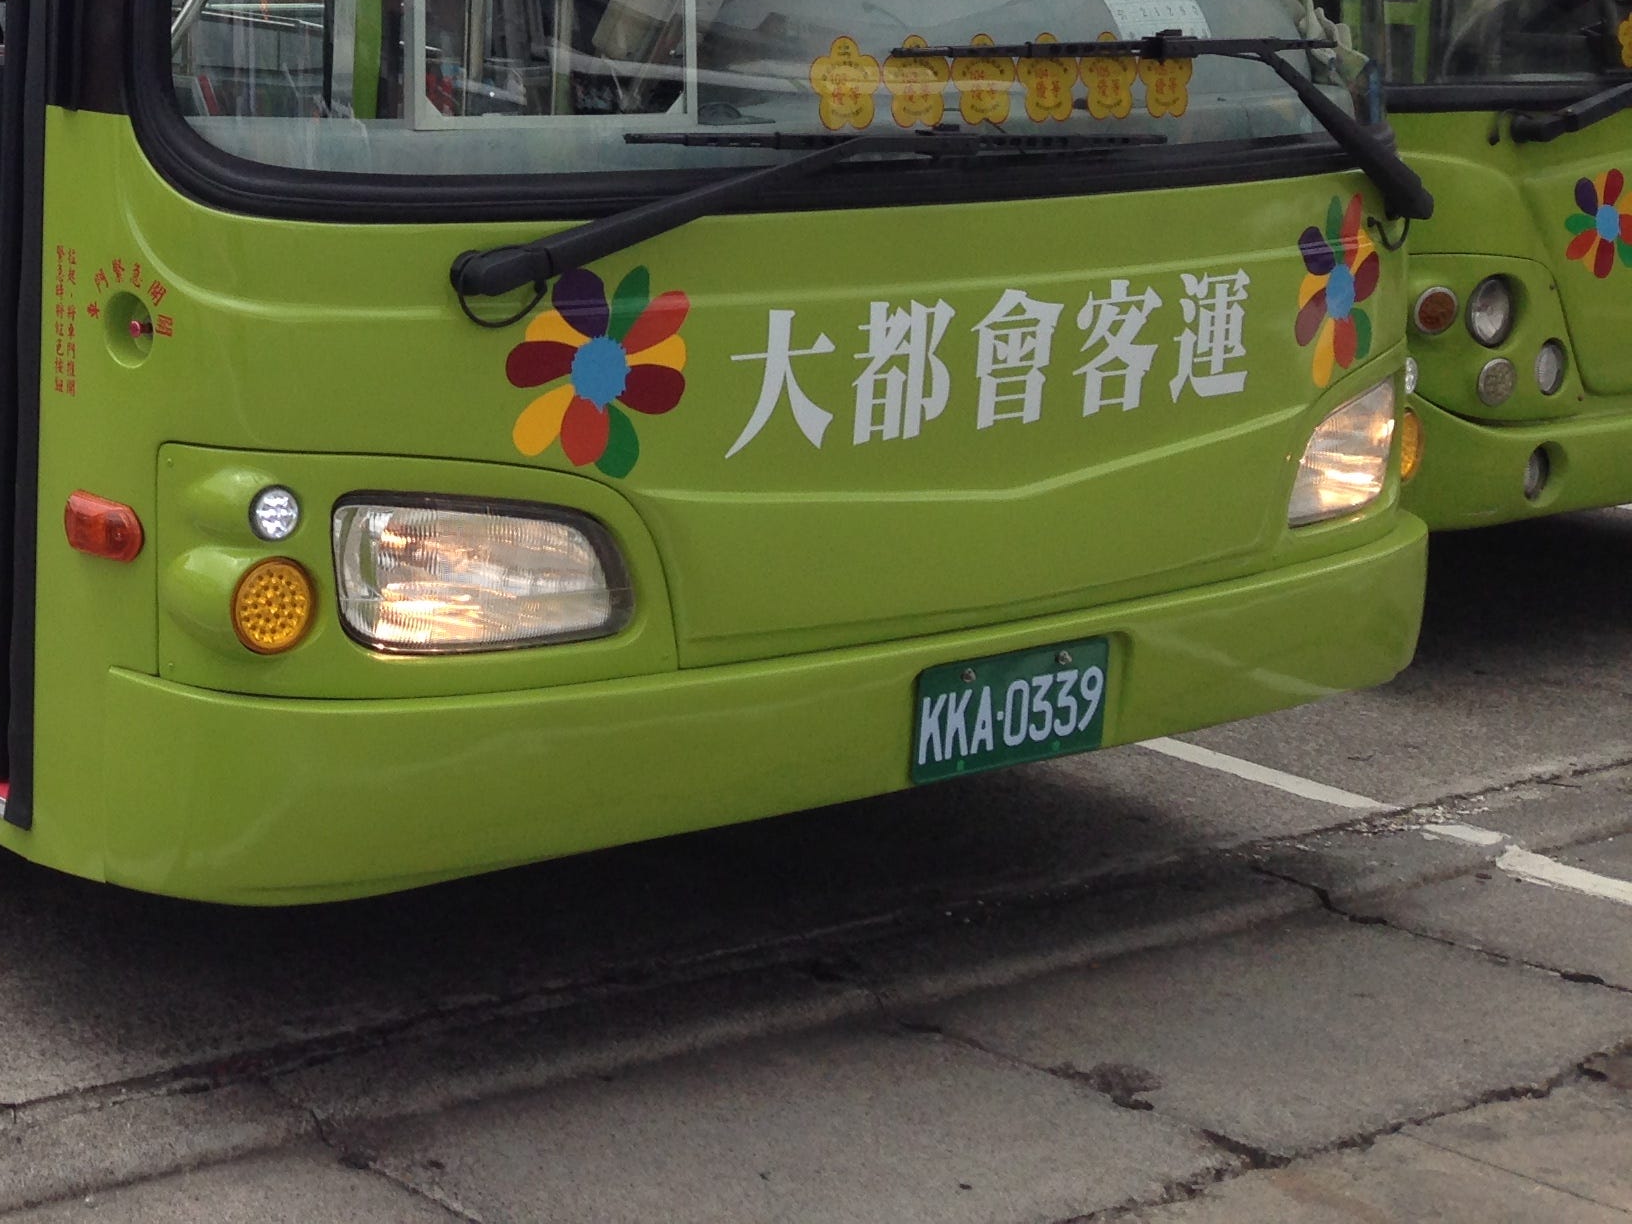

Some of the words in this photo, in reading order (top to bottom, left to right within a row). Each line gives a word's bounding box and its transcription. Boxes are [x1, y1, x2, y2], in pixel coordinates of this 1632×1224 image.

[724, 268, 1251, 460] 大都會客運
